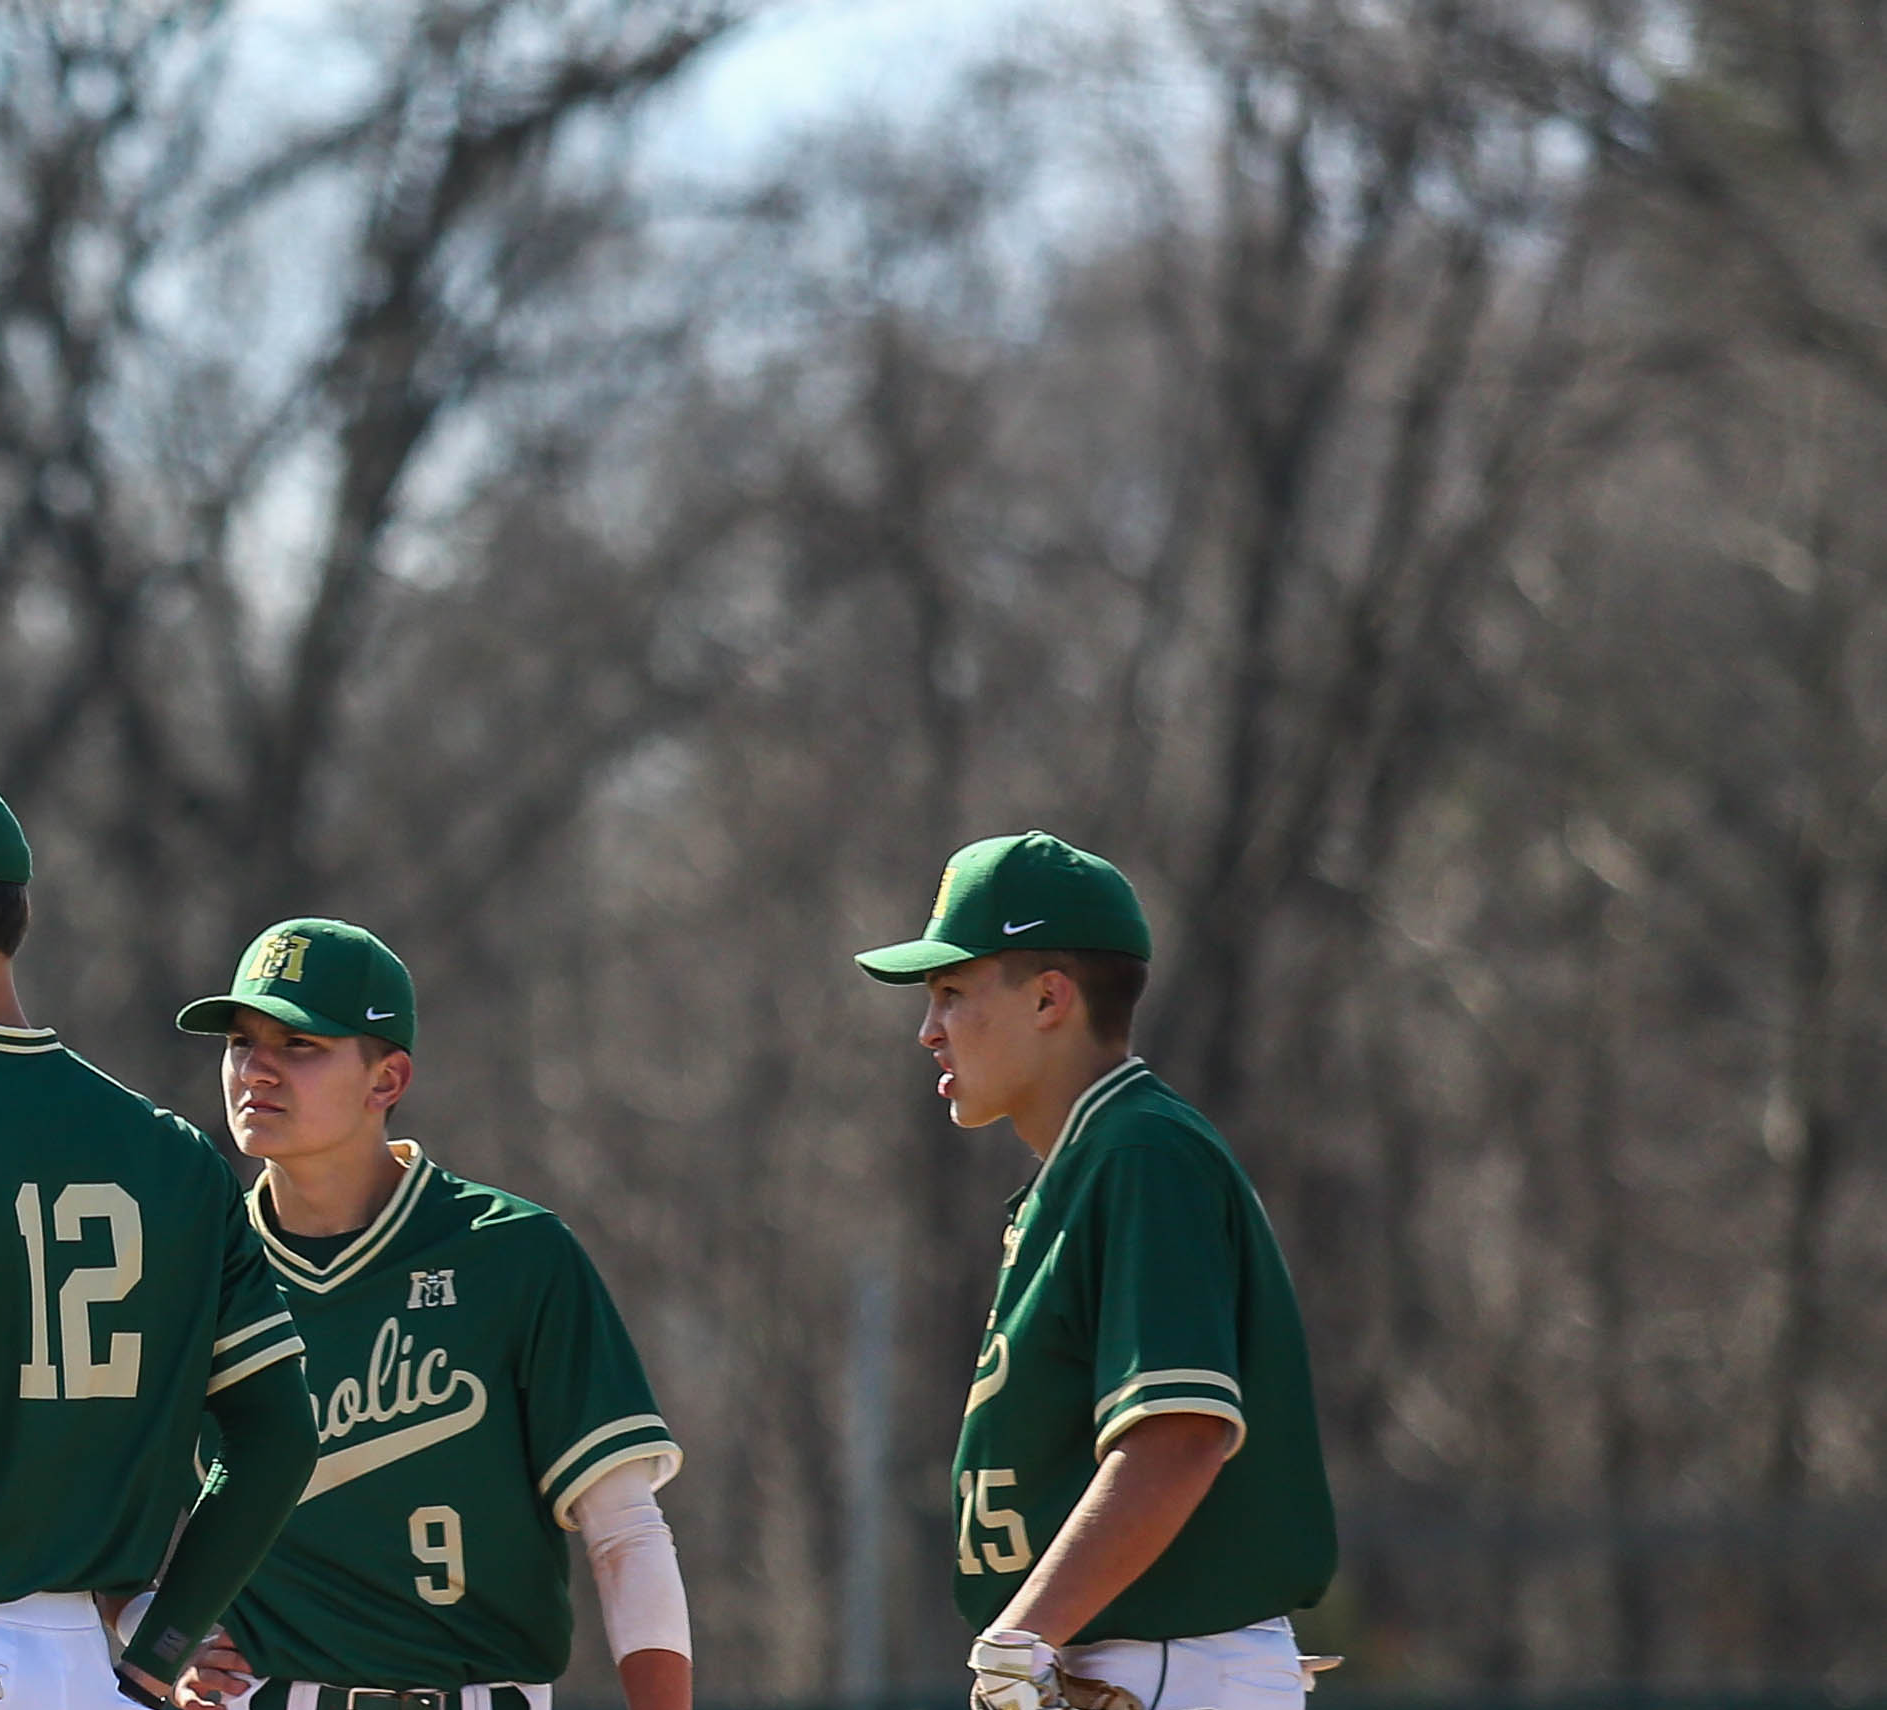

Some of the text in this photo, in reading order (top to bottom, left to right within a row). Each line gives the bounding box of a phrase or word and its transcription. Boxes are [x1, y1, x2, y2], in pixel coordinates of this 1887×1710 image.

[14, 1181, 144, 1401] 12
[304, 1316, 456, 1444] olic
[408, 1504, 466, 1606] 9
[957, 1468, 1034, 1576] 15
